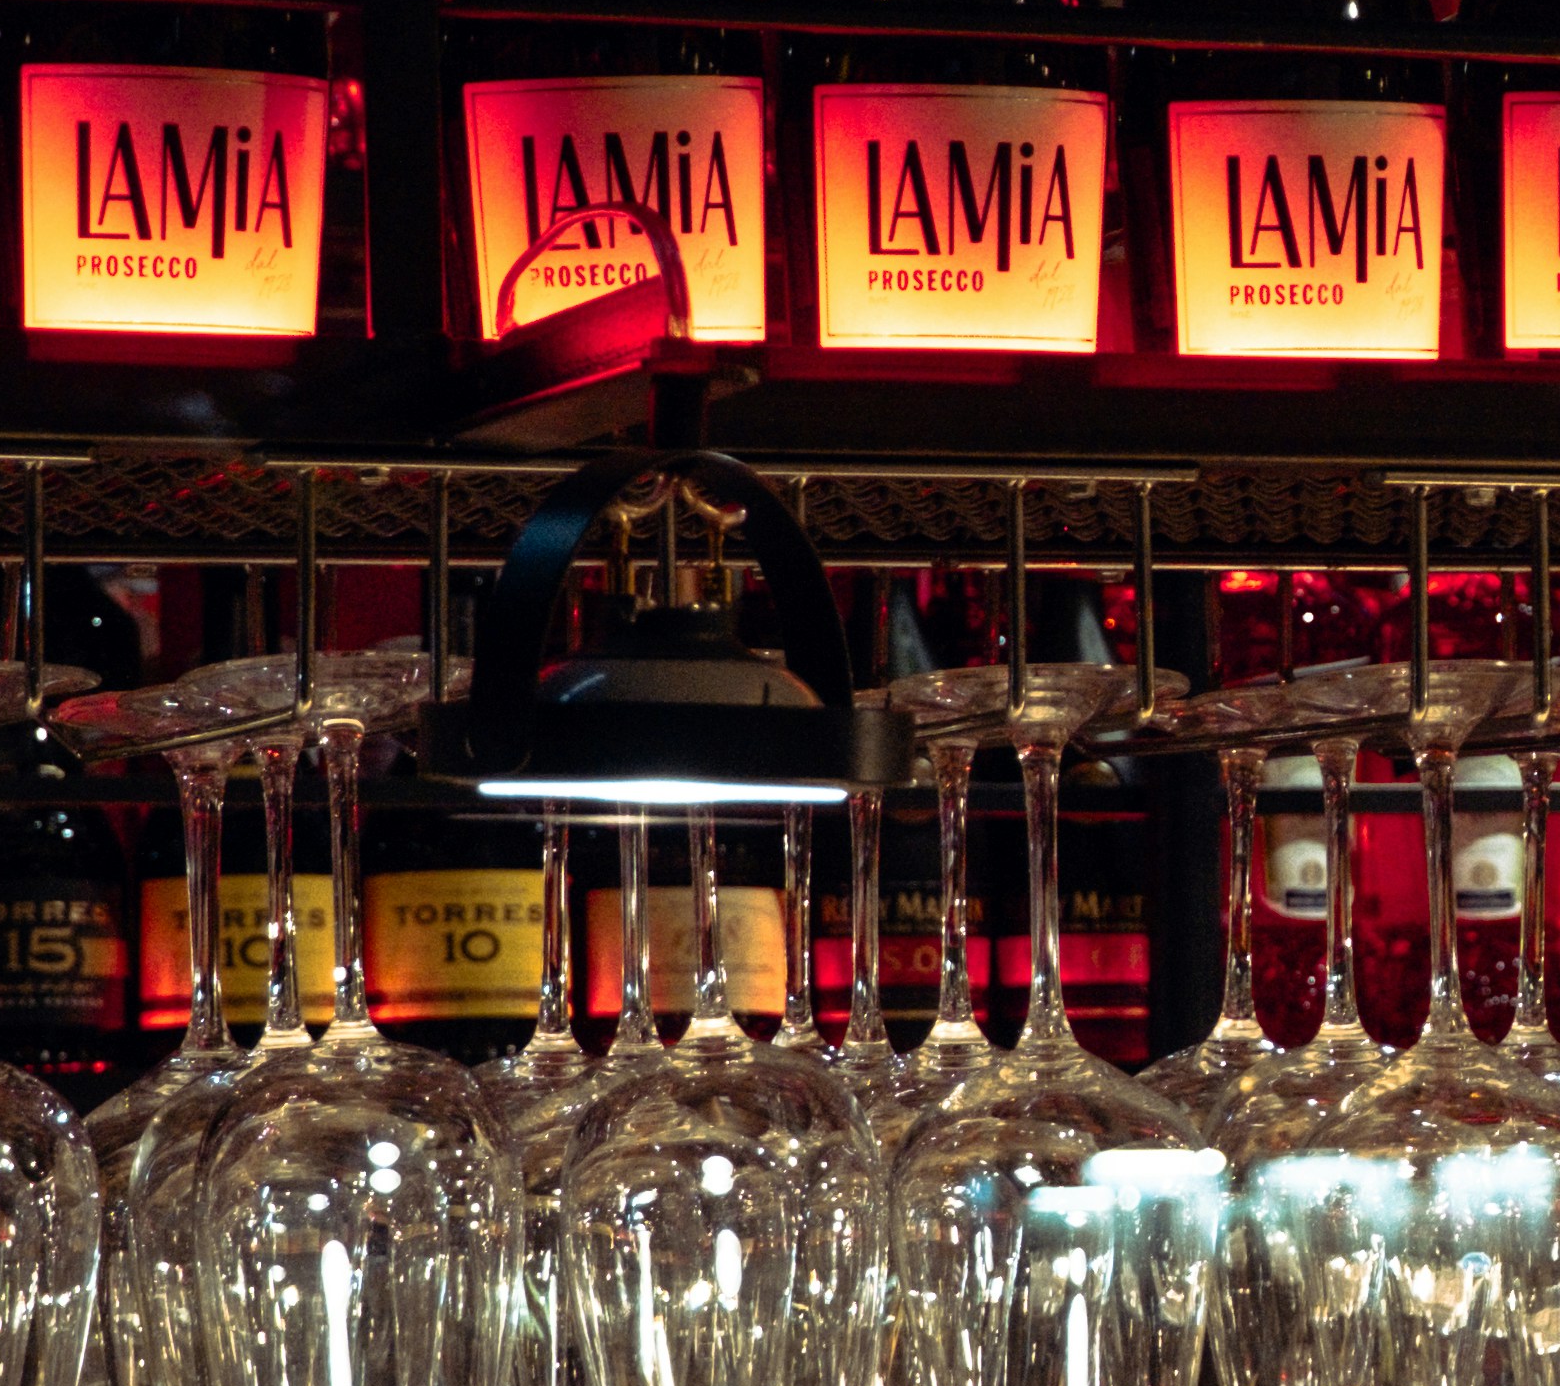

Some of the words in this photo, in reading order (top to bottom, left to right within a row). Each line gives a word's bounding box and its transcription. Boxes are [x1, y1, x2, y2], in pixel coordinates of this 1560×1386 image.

[76, 255, 198, 280] PROSECCO
[868, 270, 985, 293] PROSECCO
[1230, 283, 1344, 305] PROSECCO
[395, 902, 545, 926] TORRES
[6, 926, 78, 974] 15
[443, 929, 502, 964] 10
